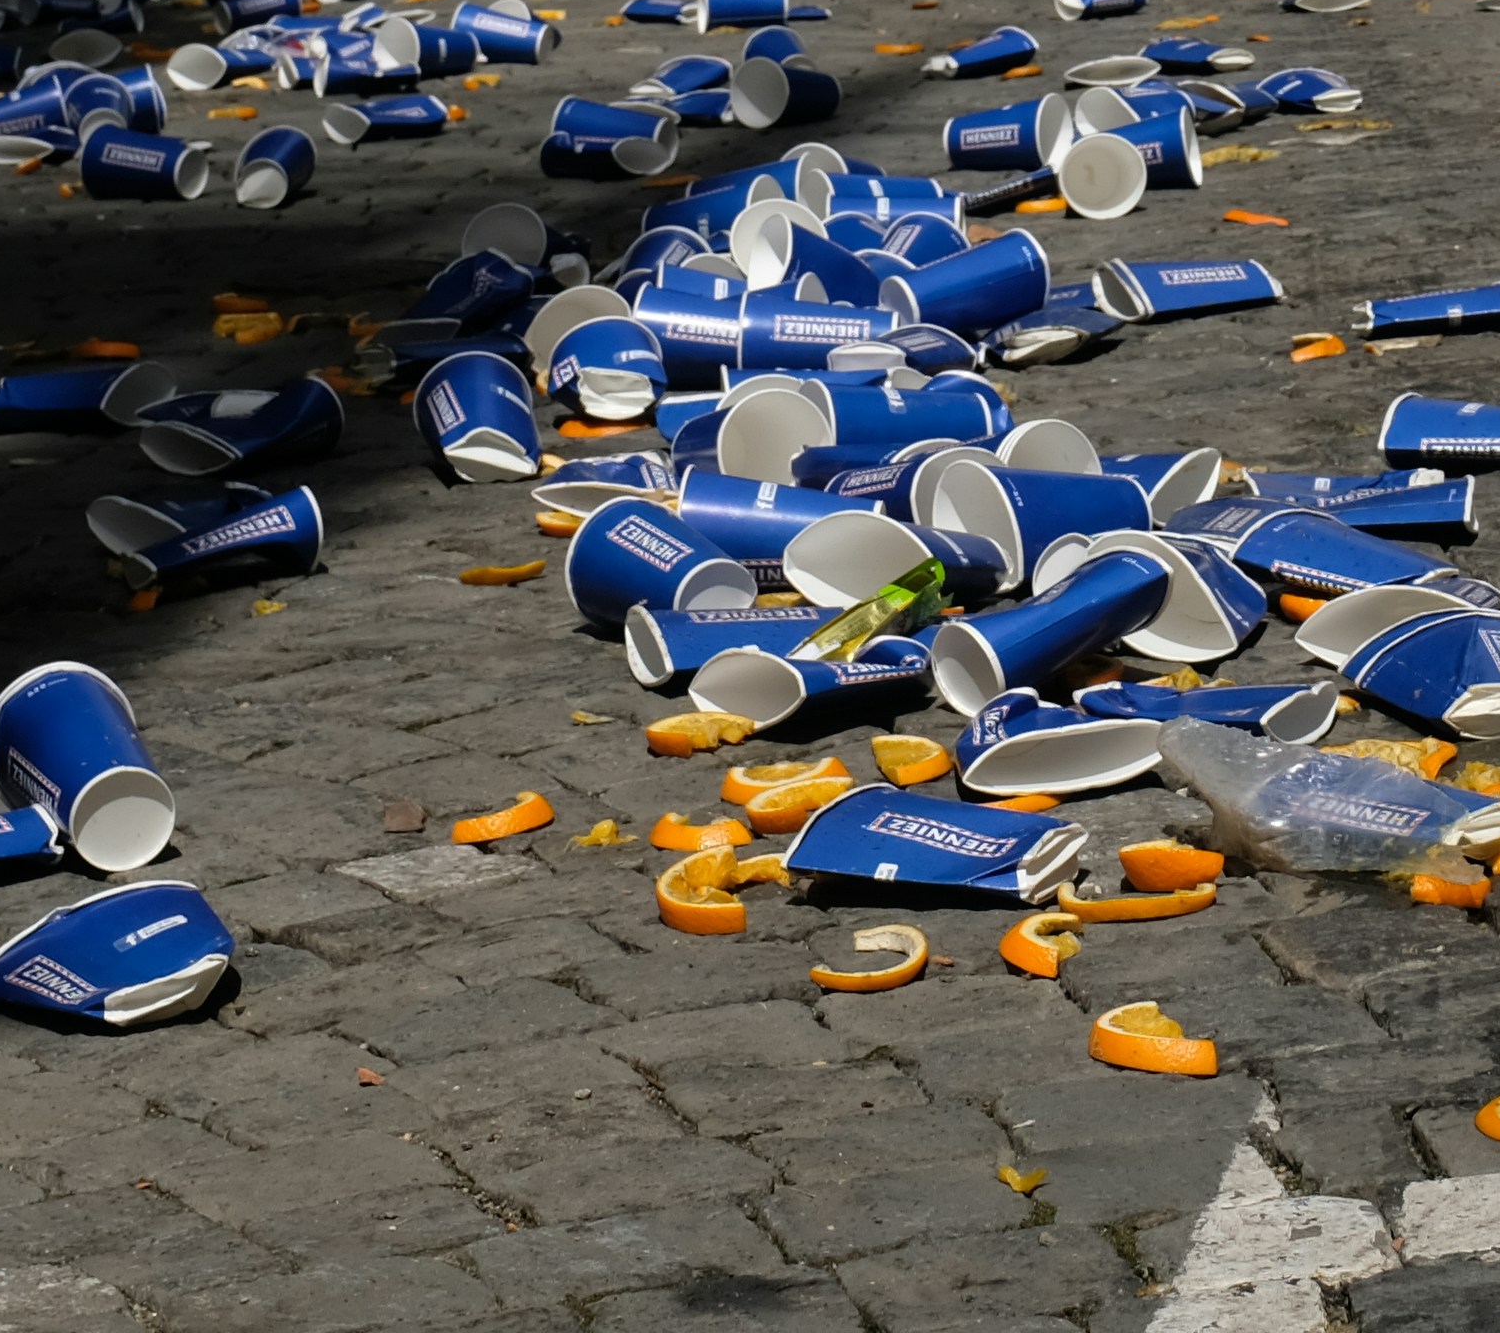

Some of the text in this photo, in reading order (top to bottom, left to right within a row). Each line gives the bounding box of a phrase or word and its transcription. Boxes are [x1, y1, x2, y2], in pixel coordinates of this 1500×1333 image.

[967, 128, 1015, 143] HENNIEZ
[1170, 268, 1241, 282] HENNIEZ
[784, 320, 862, 340] HENNIEZ
[843, 469, 899, 492] HENNIEZ
[200, 511, 285, 550] HENNIEZ
[620, 520, 684, 566] HENNIEZ
[700, 608, 812, 621] HENNIEZ
[1320, 797, 1423, 834] HENNIEZ
[888, 818, 1002, 856] HENNIEZ
[28, 961, 88, 1003] ENNIEZ
